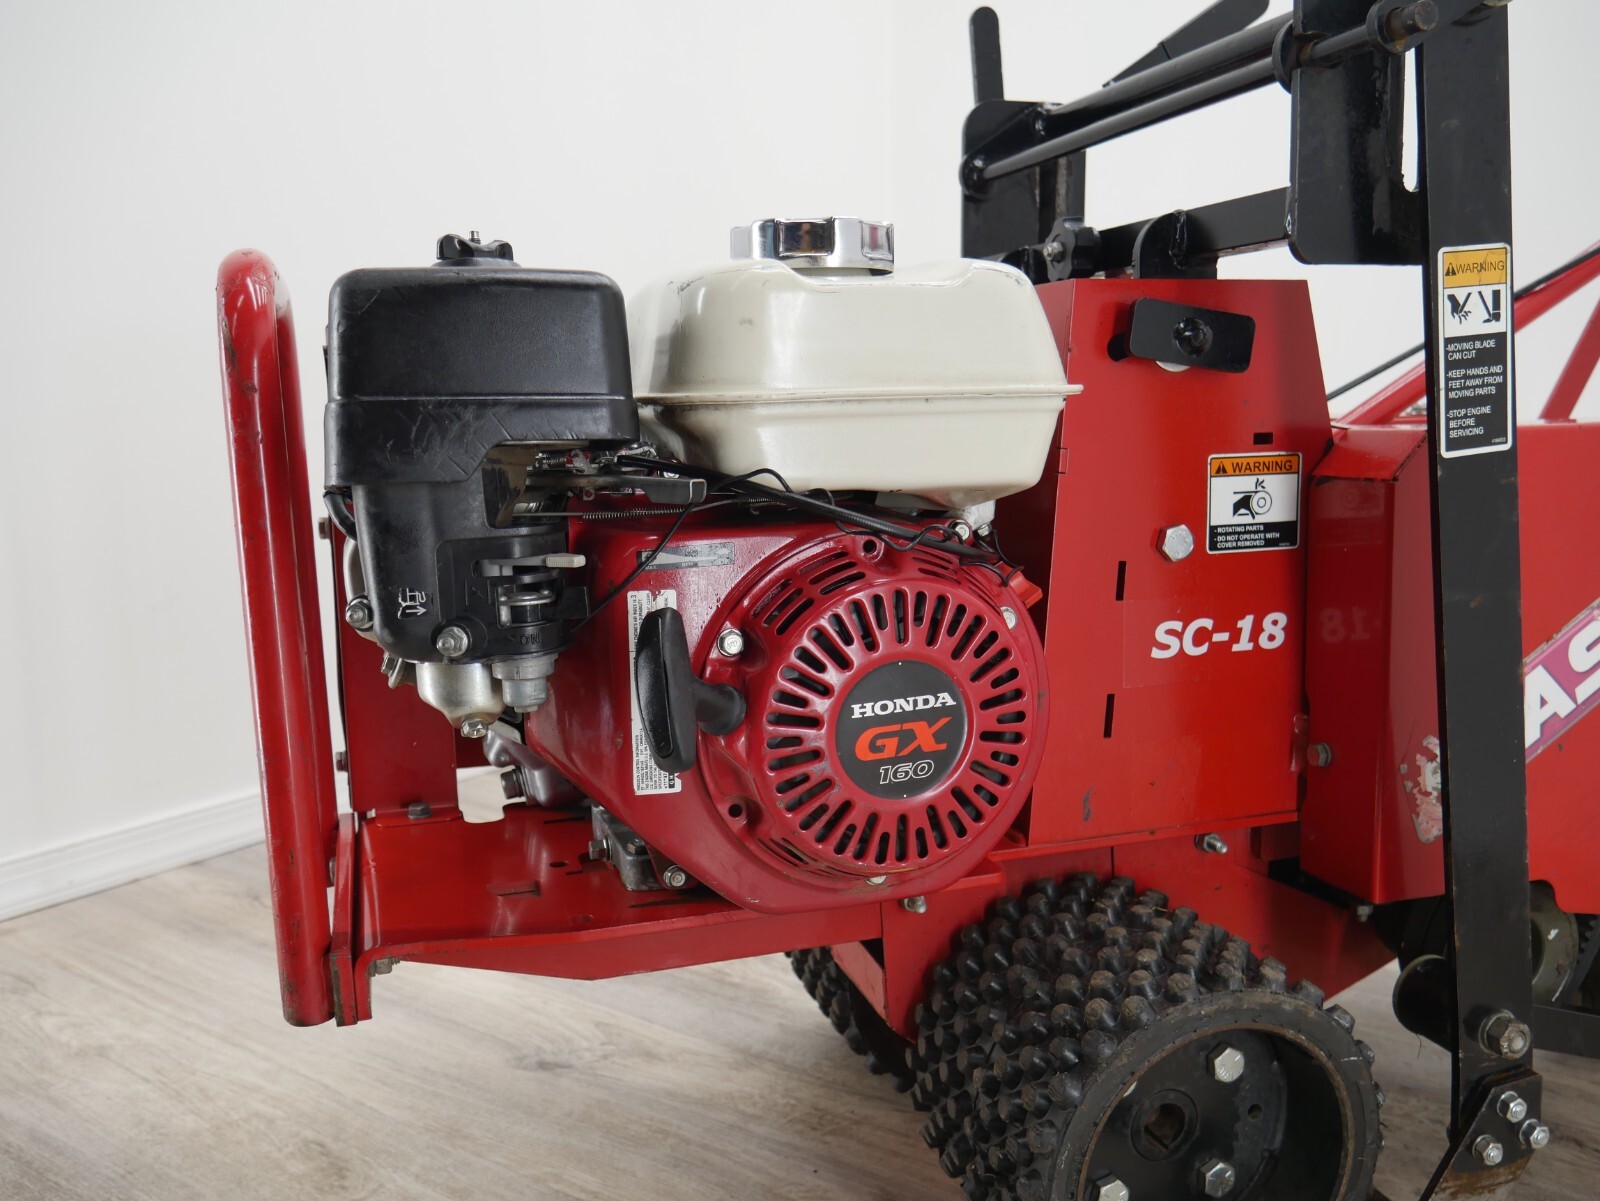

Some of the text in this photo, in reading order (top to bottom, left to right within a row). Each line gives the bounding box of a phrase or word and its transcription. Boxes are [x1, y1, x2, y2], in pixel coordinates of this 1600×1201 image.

[1456, 260, 1504, 274] WARNING
[1474, 340, 1496, 348] BLADE
[1448, 350, 1476, 360] CAN CUT
[1466, 366, 1488, 376] HANDS
[1489, 365, 1503, 373] AND
[1449, 376, 1503, 388] FEET AWAY FROM
[1449, 386, 1496, 399] MOVING PARTS
[1467, 406, 1491, 416] ENGINE
[1450, 418, 1475, 428] BEFORE
[1450, 427, 1484, 438] SERVICING
[1231, 460, 1293, 473] WARNING
[1150, 612, 1288, 659] SC-18
[851, 692, 956, 718] HONDA
[854, 717, 952, 761] GX
[880, 760, 934, 784] 160
